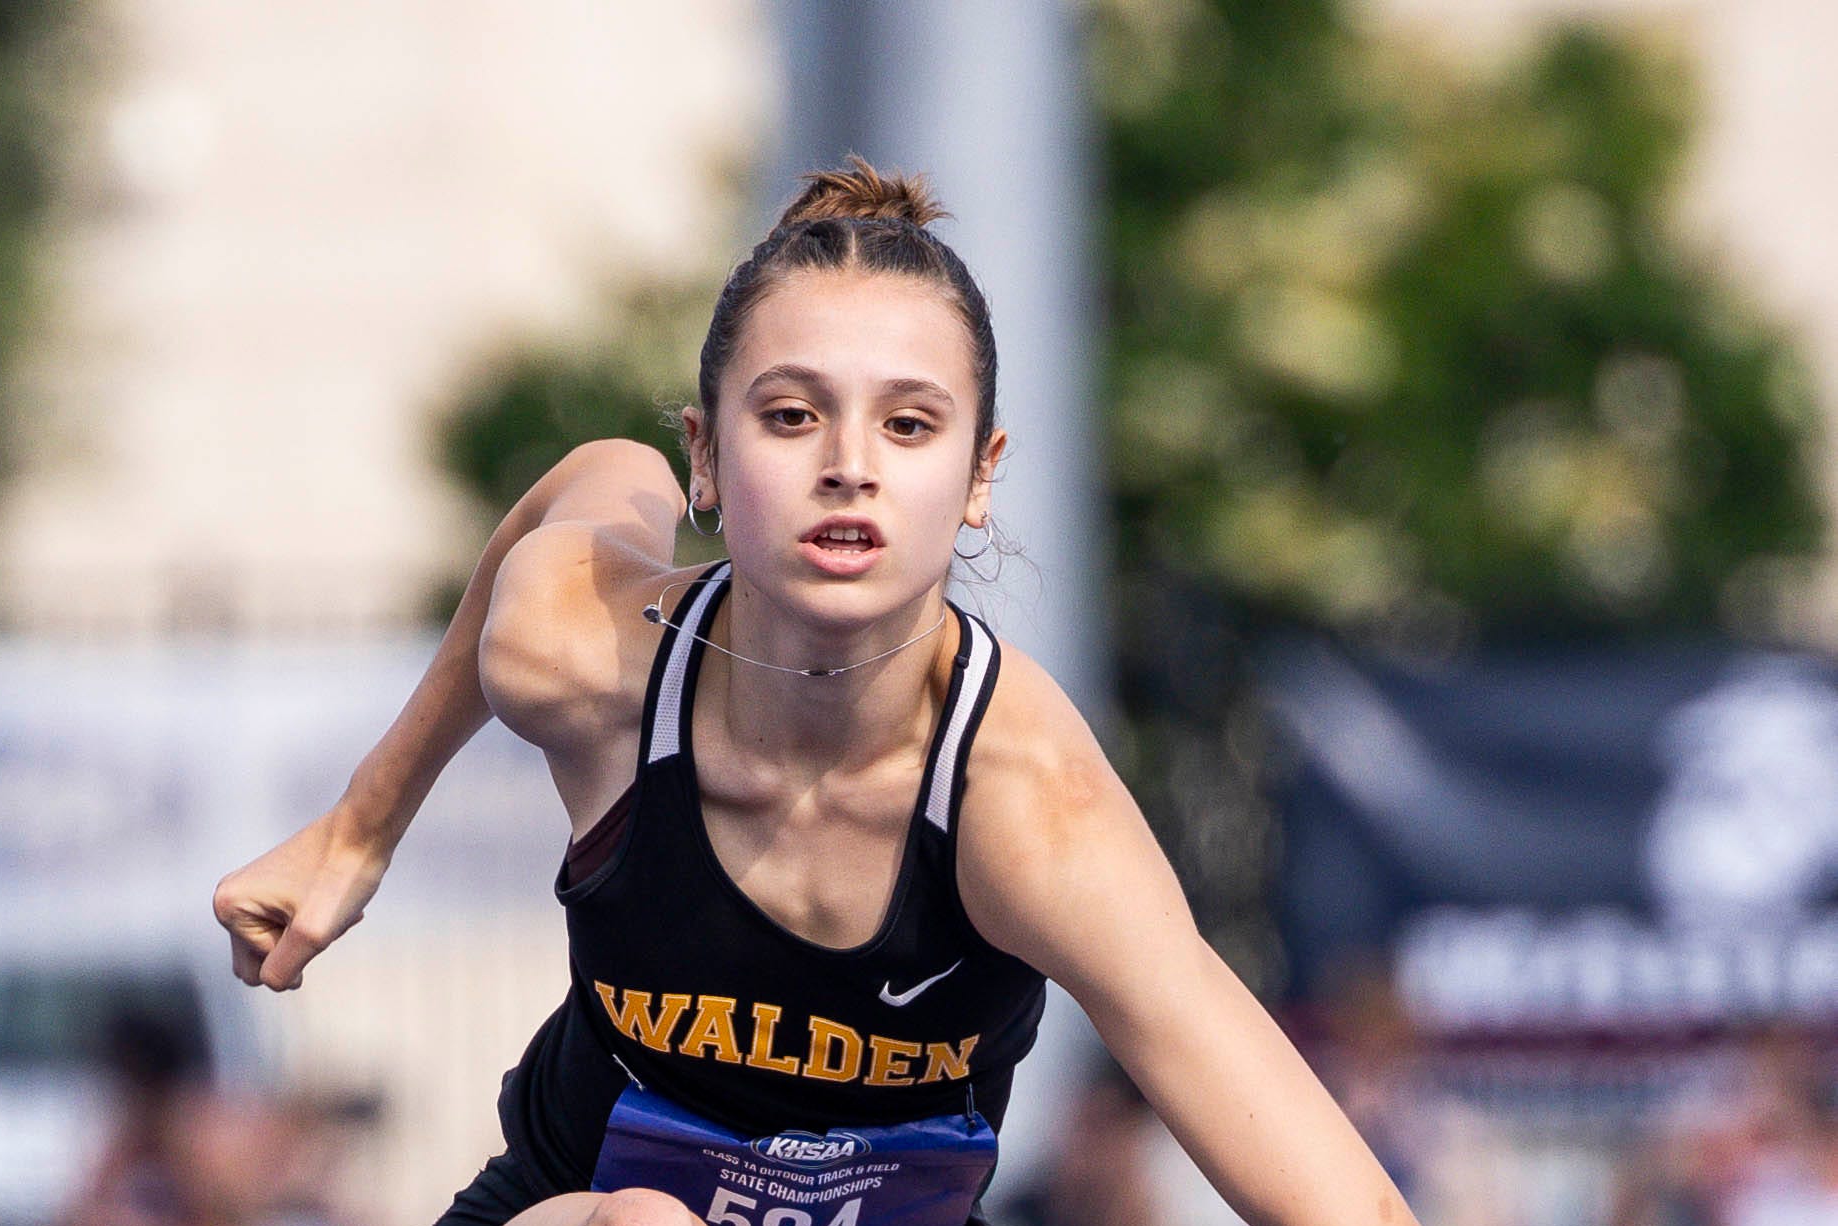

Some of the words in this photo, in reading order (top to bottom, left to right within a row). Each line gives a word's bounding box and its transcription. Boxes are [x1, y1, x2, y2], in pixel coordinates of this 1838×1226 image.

[594, 980, 980, 1087] WALDEN
[765, 1136, 856, 1161] KHSAA
[702, 1149, 739, 1165] CLASS
[743, 1160, 757, 1172] 1A
[759, 1167, 815, 1185] OUTDOOR
[817, 1167, 853, 1185] TRACK
[855, 1164, 865, 1174] &
[866, 1163, 900, 1172] FIELD
[719, 1168, 765, 1192] STATE
[767, 1177, 883, 1204] CHAMPIONSHIPS
